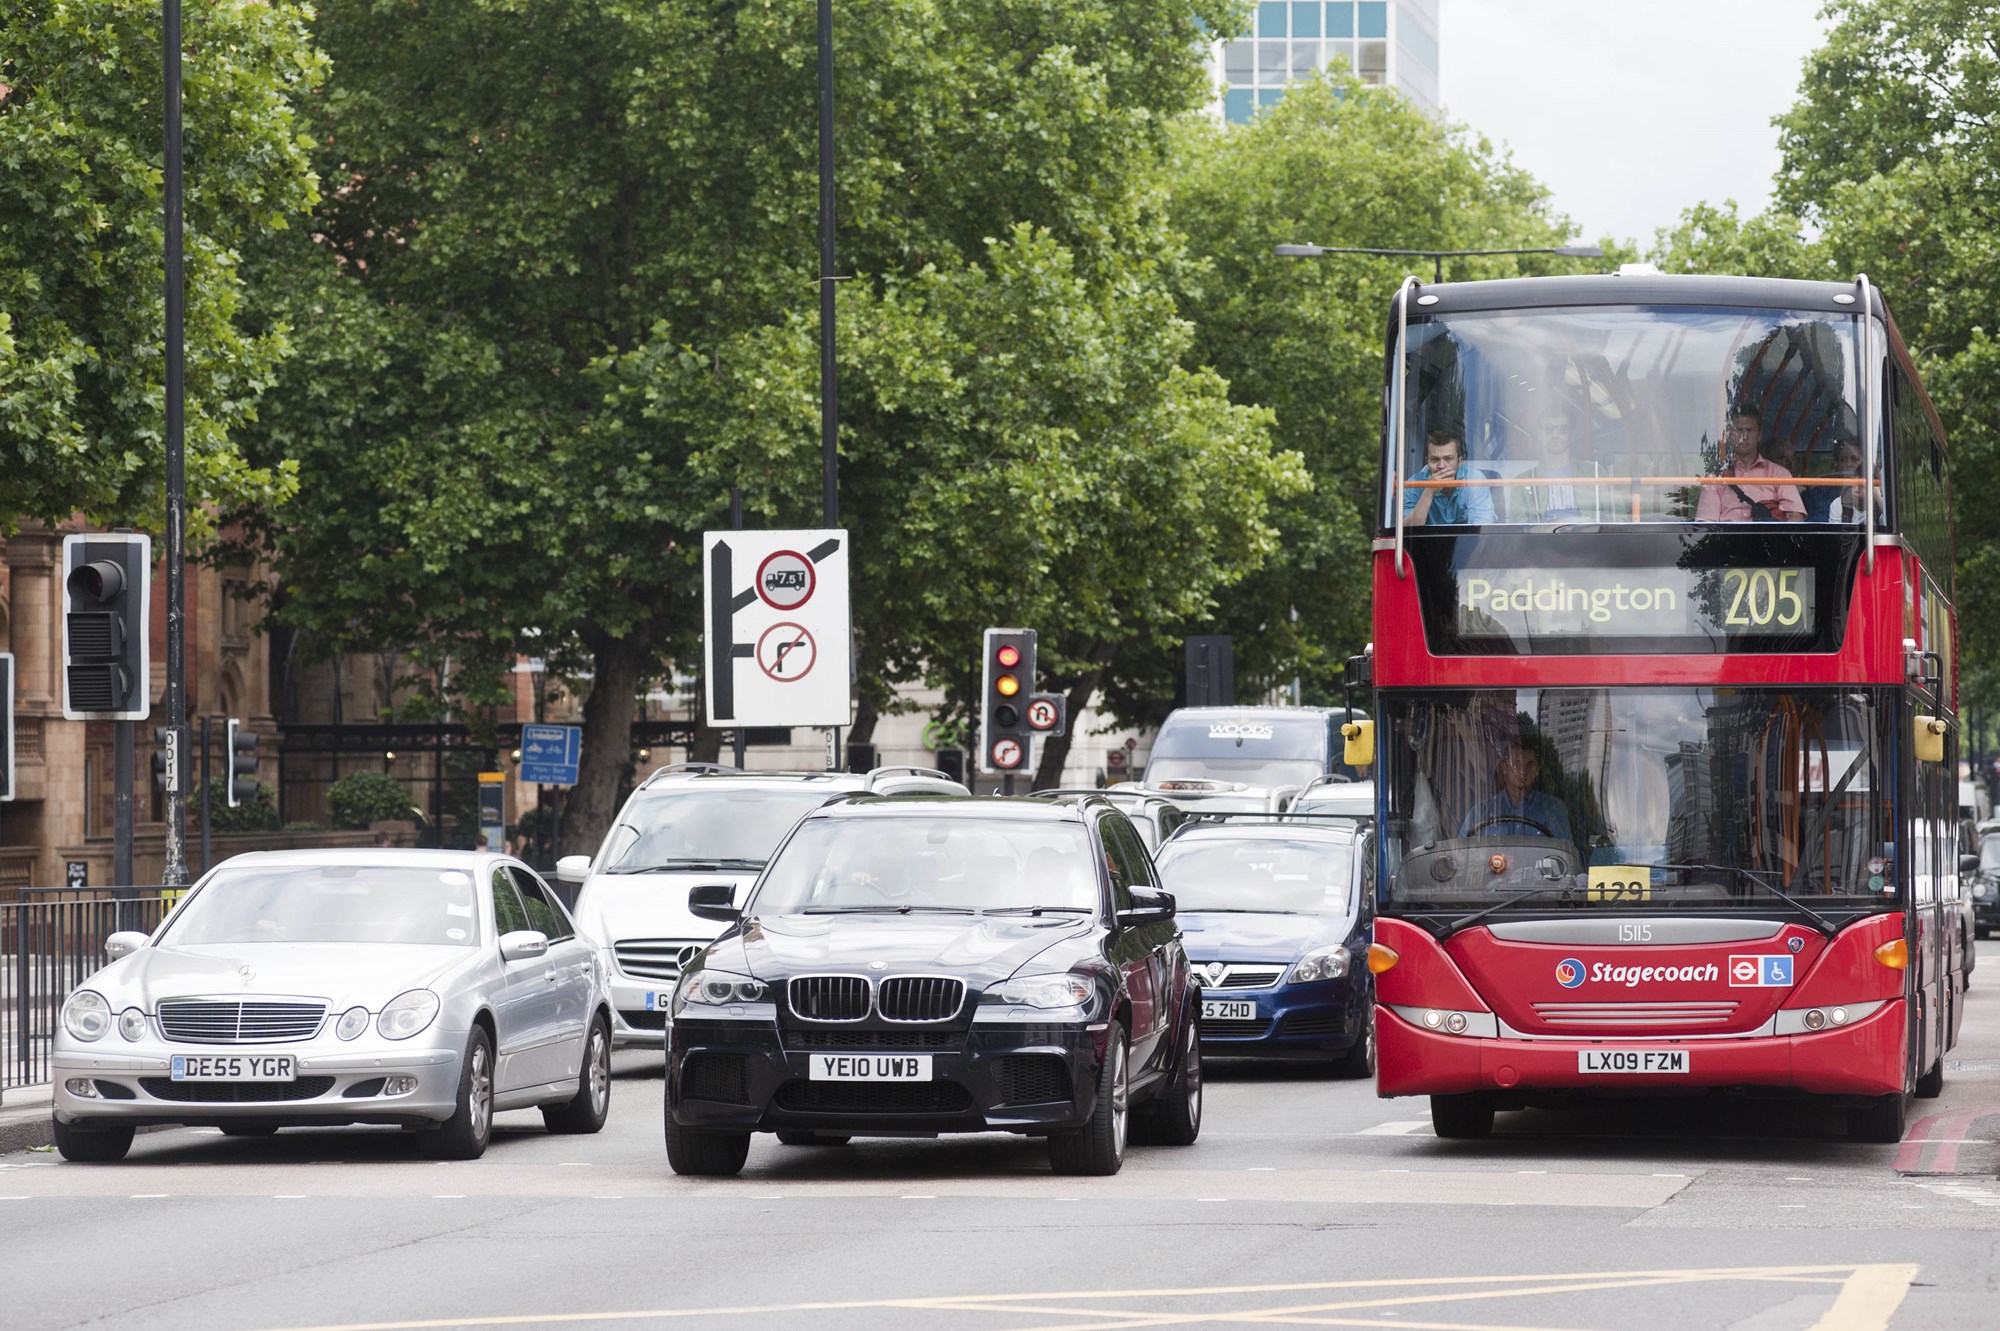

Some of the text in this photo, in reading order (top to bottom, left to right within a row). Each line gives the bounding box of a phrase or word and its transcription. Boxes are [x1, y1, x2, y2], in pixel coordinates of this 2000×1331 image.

[1468, 569, 1802, 626] Paddington 205
[1209, 724, 1273, 734] WOODS
[166, 733, 174, 788] 0017
[1595, 881, 1643, 901] 129
[1619, 924, 1652, 942] 15115
[1590, 962, 1719, 987] Stagecoach
[1219, 1002, 1250, 1017] ZHD
[186, 1058, 290, 1077] DE55 YGR
[824, 1057, 919, 1077] YE10 UWB
[1587, 1052, 1682, 1070] LX09 FZM
